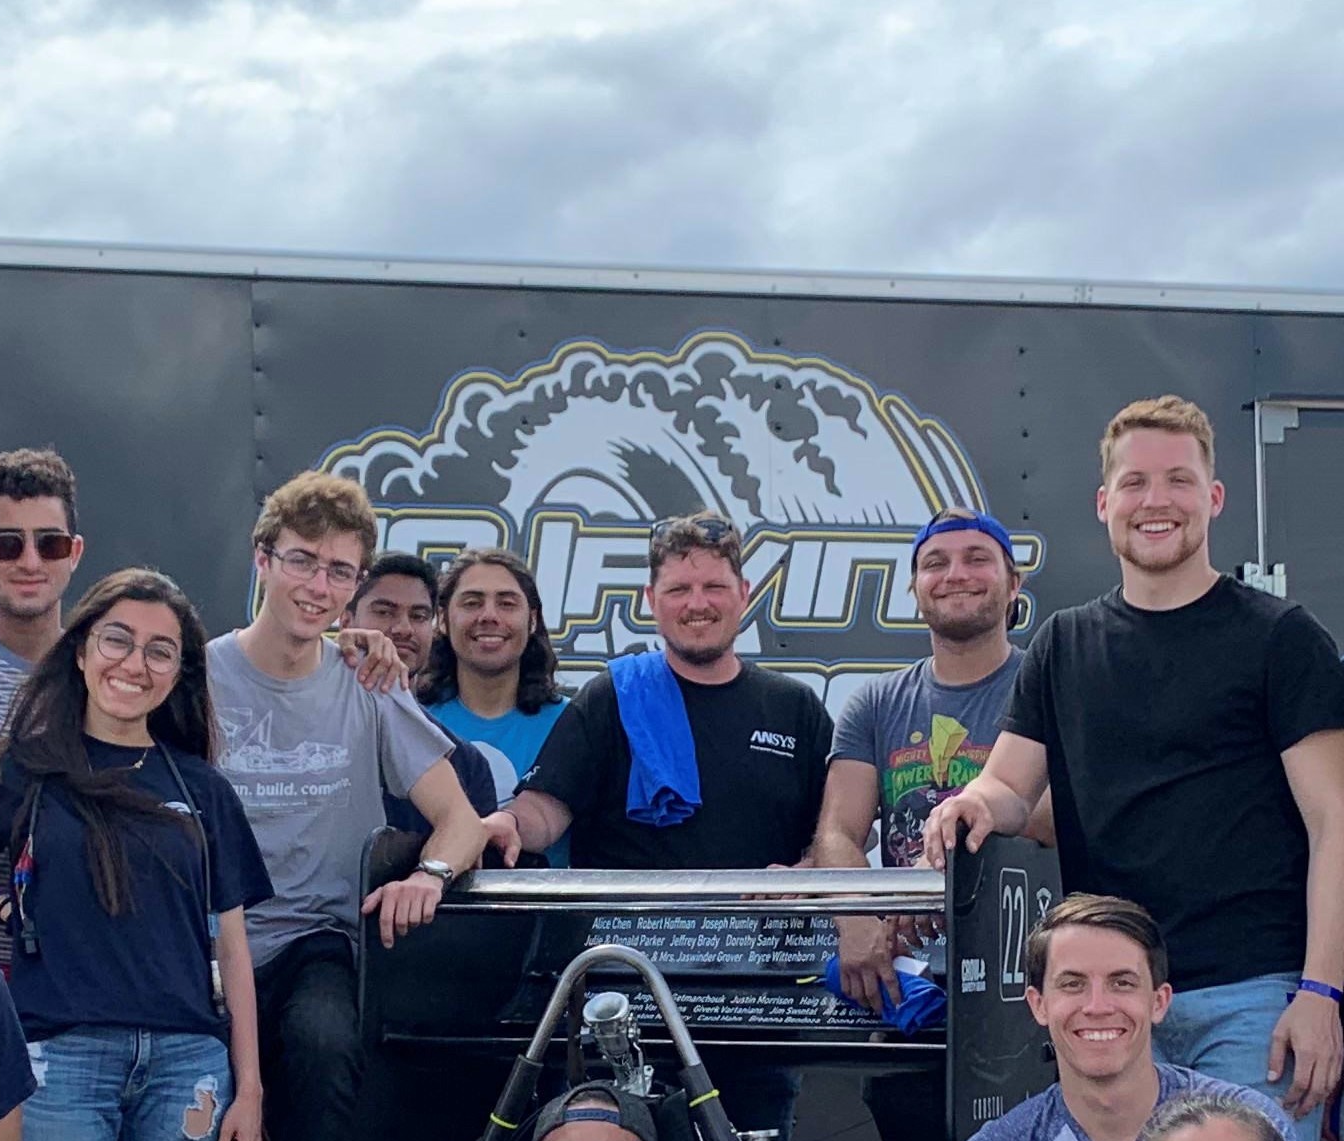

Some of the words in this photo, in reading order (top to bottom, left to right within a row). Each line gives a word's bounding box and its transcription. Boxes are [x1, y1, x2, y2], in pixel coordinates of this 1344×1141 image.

[750, 730, 796, 750] ANSYS
[256, 782, 298, 796] build.
[592, 916, 611, 930] Alice
[612, 916, 632, 930] Chen
[637, 916, 663, 930] Robert
[663, 916, 696, 930] Hoffman
[700, 916, 729, 932] Joseph
[762, 916, 789, 930] James
[789, 916, 805, 929] Wei
[809, 916, 829, 929] Nina
[639, 934, 666, 947] Parker
[669, 934, 697, 949] Jeffrey
[696, 934, 721, 949] Brady
[725, 934, 756, 949] Dorothy
[756, 934, 781, 948] Santy
[784, 934, 816, 946] Michael
[1002, 884, 1025, 984] 22
[716, 951, 744, 963] Grover
[748, 951, 772, 966] Bryce
[730, 994, 757, 1005] Justin
